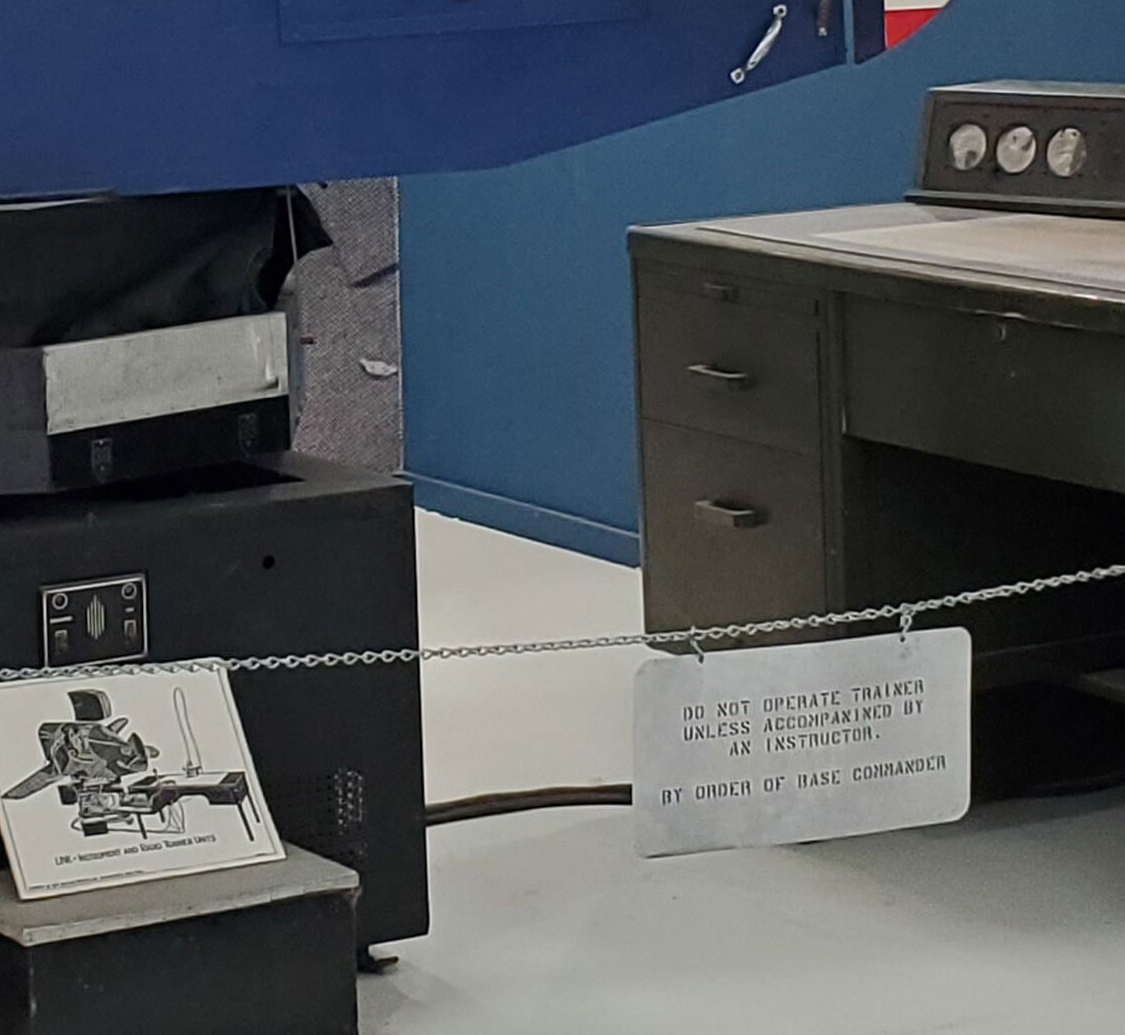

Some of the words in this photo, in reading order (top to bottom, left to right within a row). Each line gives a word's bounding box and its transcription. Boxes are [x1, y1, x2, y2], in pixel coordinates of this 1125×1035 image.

[683, 705, 704, 722] DO
[717, 700, 750, 717] NOT
[763, 690, 840, 713] OPERATE
[851, 679, 924, 703] TRAINER
[683, 720, 750, 741] UNLESS
[903, 700, 923, 716] BY
[729, 740, 751, 757] AN
[766, 726, 880, 753] INSTRUCTOR.
[661, 787, 683, 806] BY
[695, 780, 751, 800] ORDER
[763, 775, 786, 793] OF
[797, 769, 841, 789] BASE
[852, 754, 946, 781] COMMANDER
